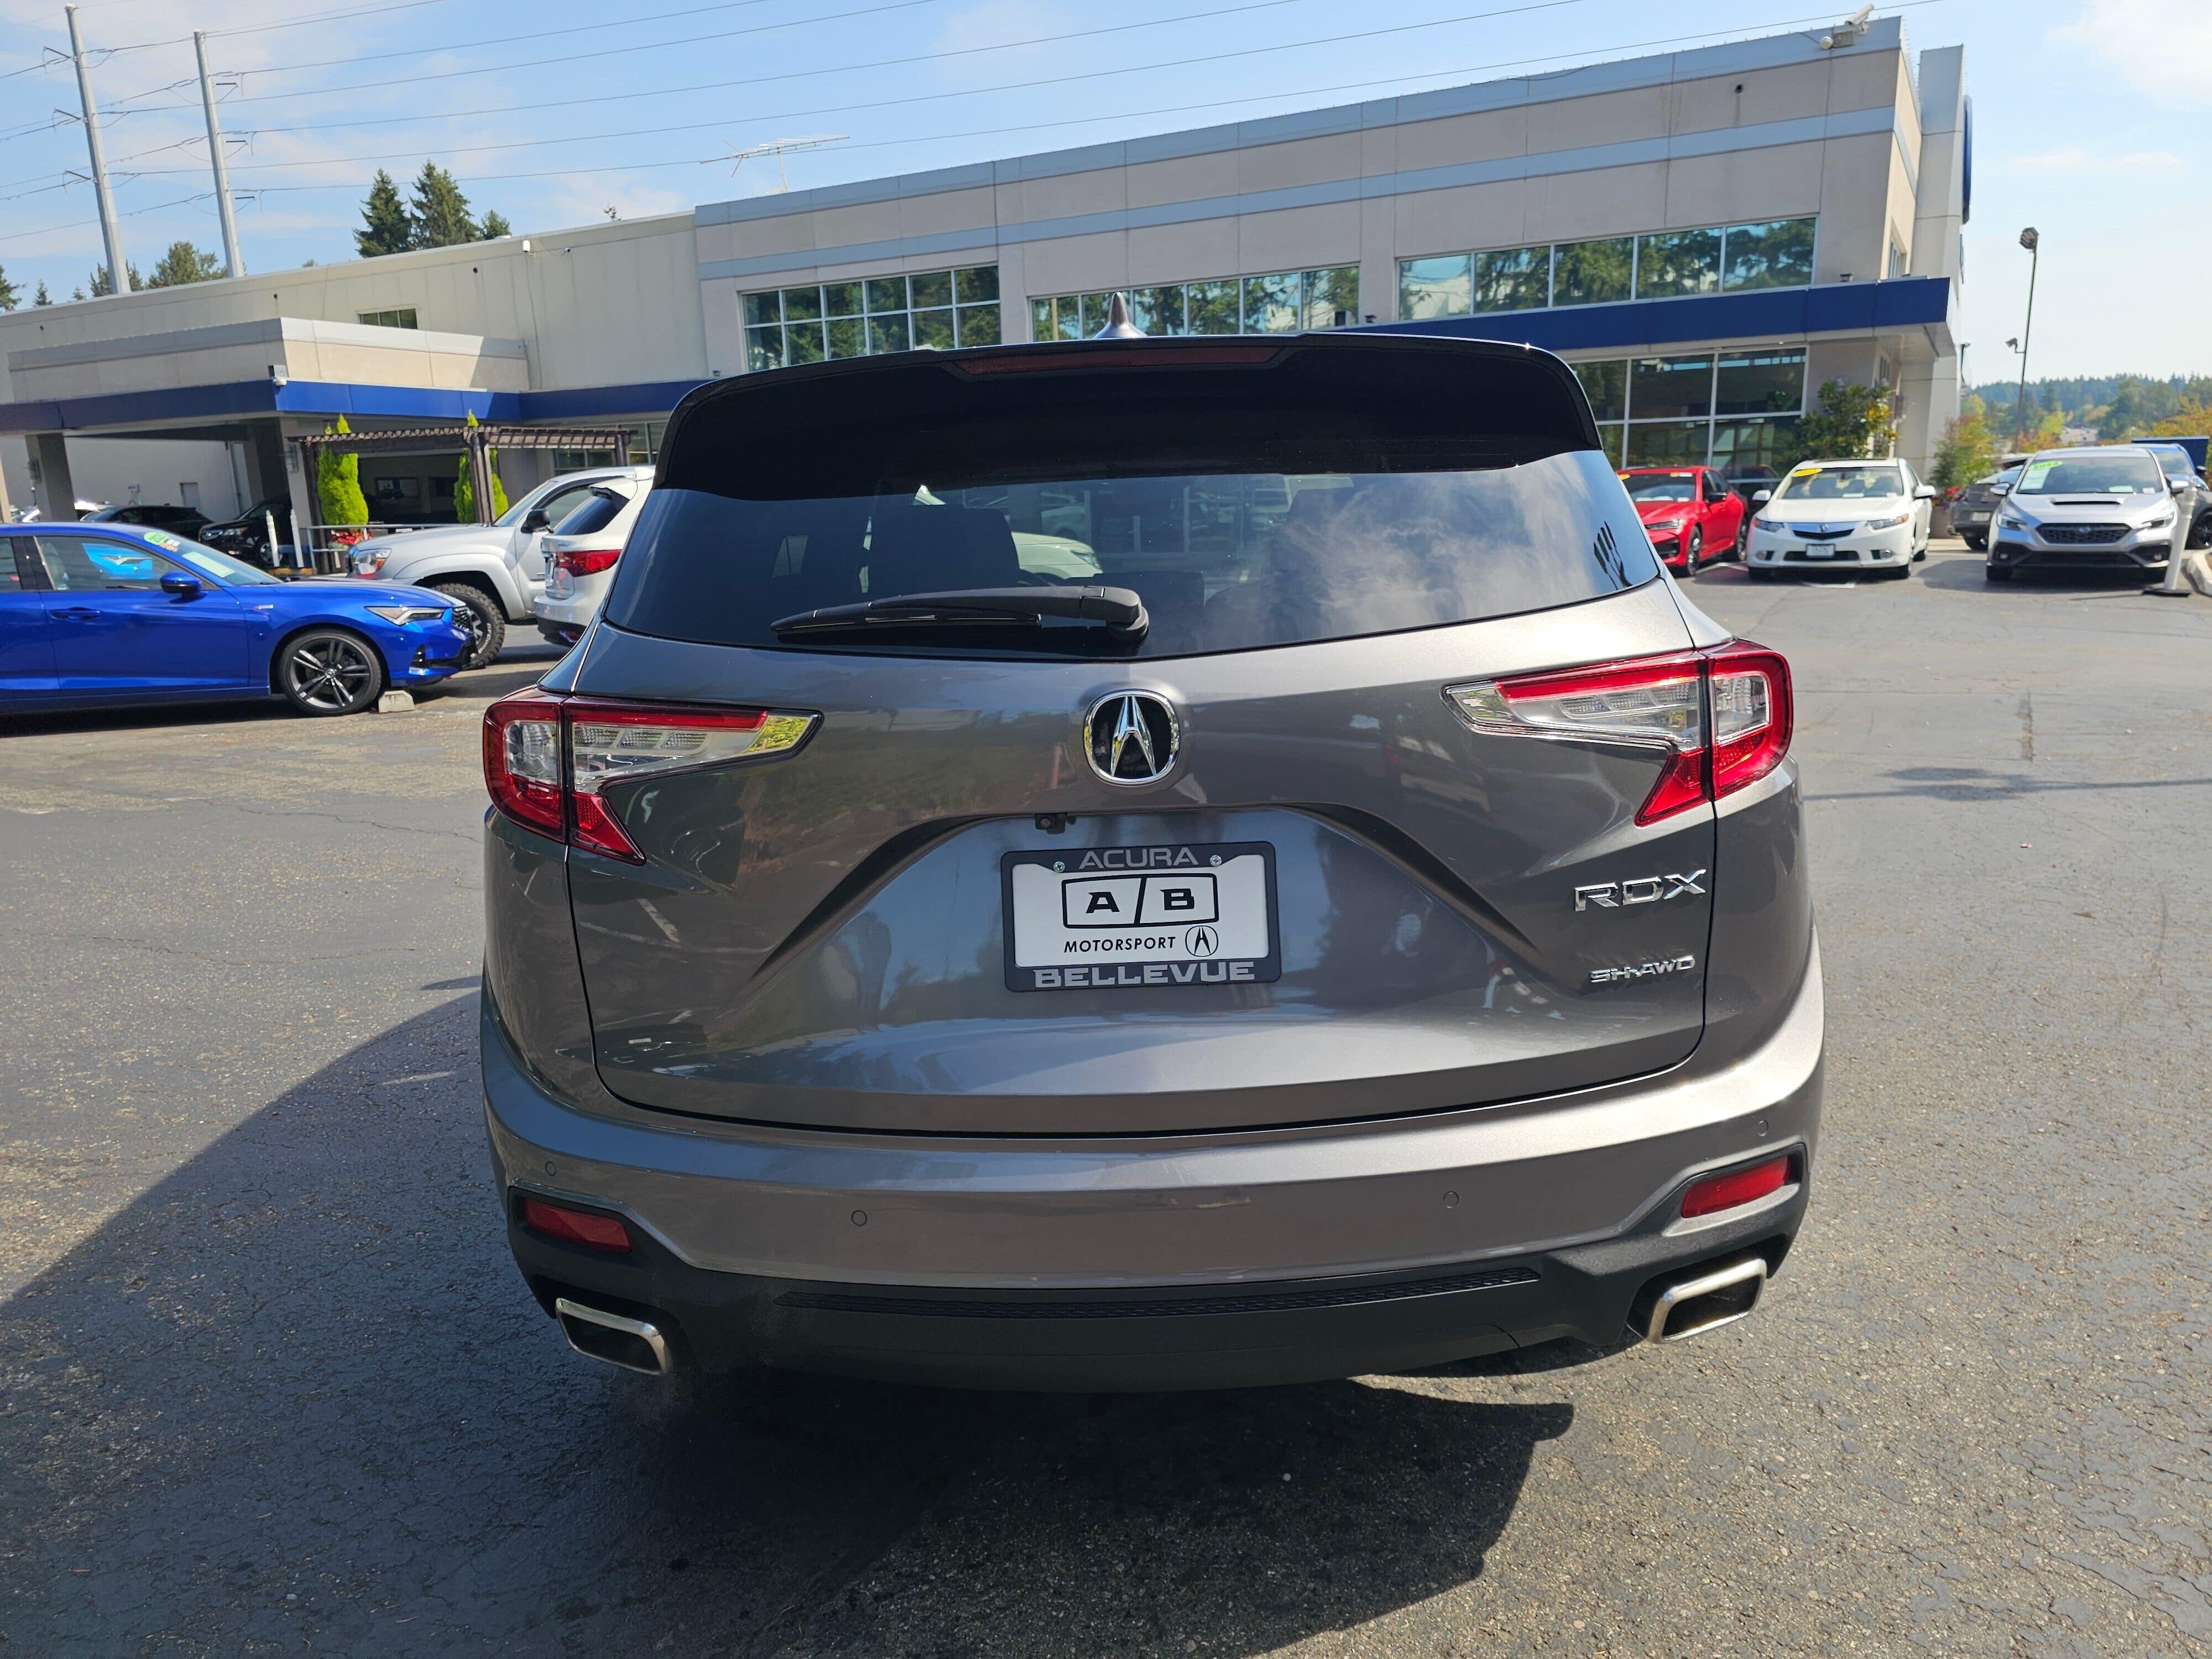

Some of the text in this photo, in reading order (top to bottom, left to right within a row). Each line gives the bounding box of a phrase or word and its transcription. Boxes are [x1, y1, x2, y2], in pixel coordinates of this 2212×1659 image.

[1078, 847, 1199, 870] ACURA
[1574, 869, 1707, 912] RDX
[1064, 936, 1176, 953] MOTORSPORT
[1032, 961, 1255, 988] BELLEVUE
[1589, 954, 1696, 983] SH-AWD
